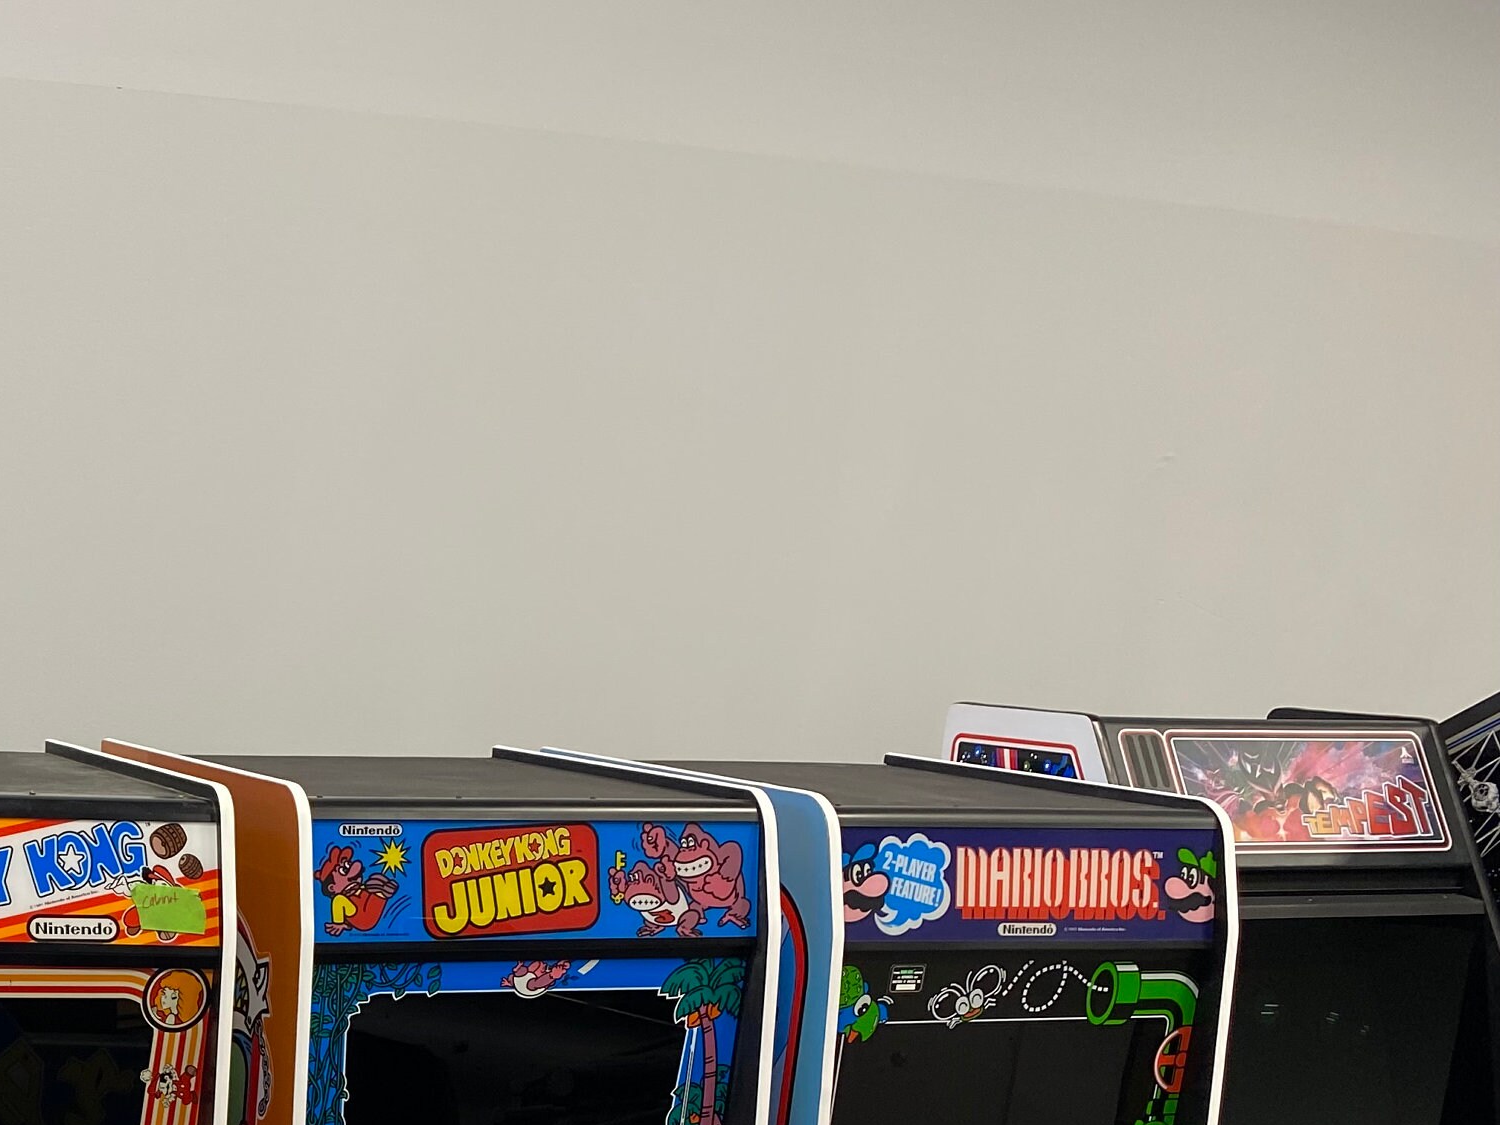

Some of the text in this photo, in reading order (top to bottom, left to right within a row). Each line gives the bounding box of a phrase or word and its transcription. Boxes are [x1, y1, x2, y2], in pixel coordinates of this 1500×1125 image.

[1302, 775, 1433, 837] TEMPEST
[342, 825, 401, 836] Nintendo
[24, 820, 147, 897] KONG
[435, 827, 571, 878] DONKEY KONG
[882, 851, 937, 882] 2-PLAYER
[434, 859, 590, 934] JUNIOR
[889, 878, 941, 907] FEATURE!
[956, 846, 1067, 914] MARIO
[35, 922, 113, 935] Nintendo
[1002, 924, 1054, 935] Nintendo
